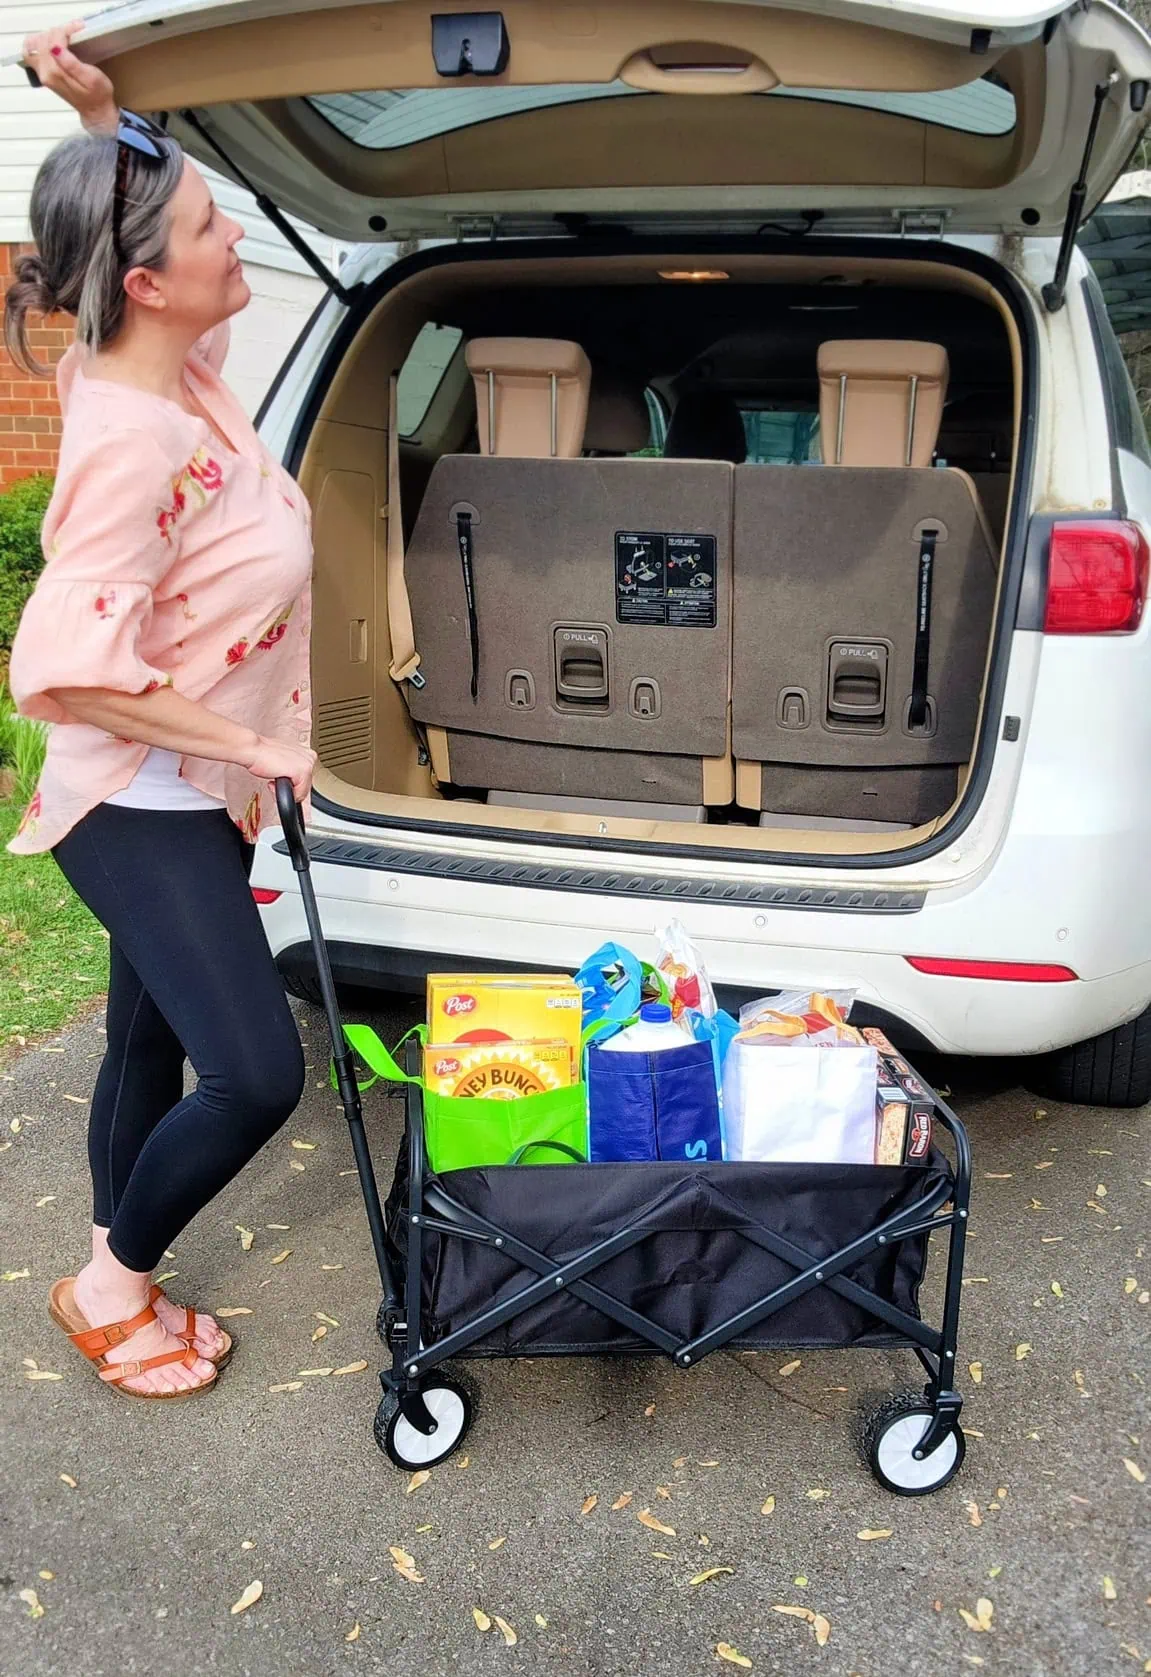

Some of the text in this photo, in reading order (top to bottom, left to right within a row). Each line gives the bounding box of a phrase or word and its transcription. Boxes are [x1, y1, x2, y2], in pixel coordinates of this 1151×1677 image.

[849, 649, 867, 657] PULL
[447, 996, 474, 1014] Post
[436, 1060, 458, 1074] Post
[491, 1069, 539, 1096] BUNC
[918, 1116, 928, 1130] RED
